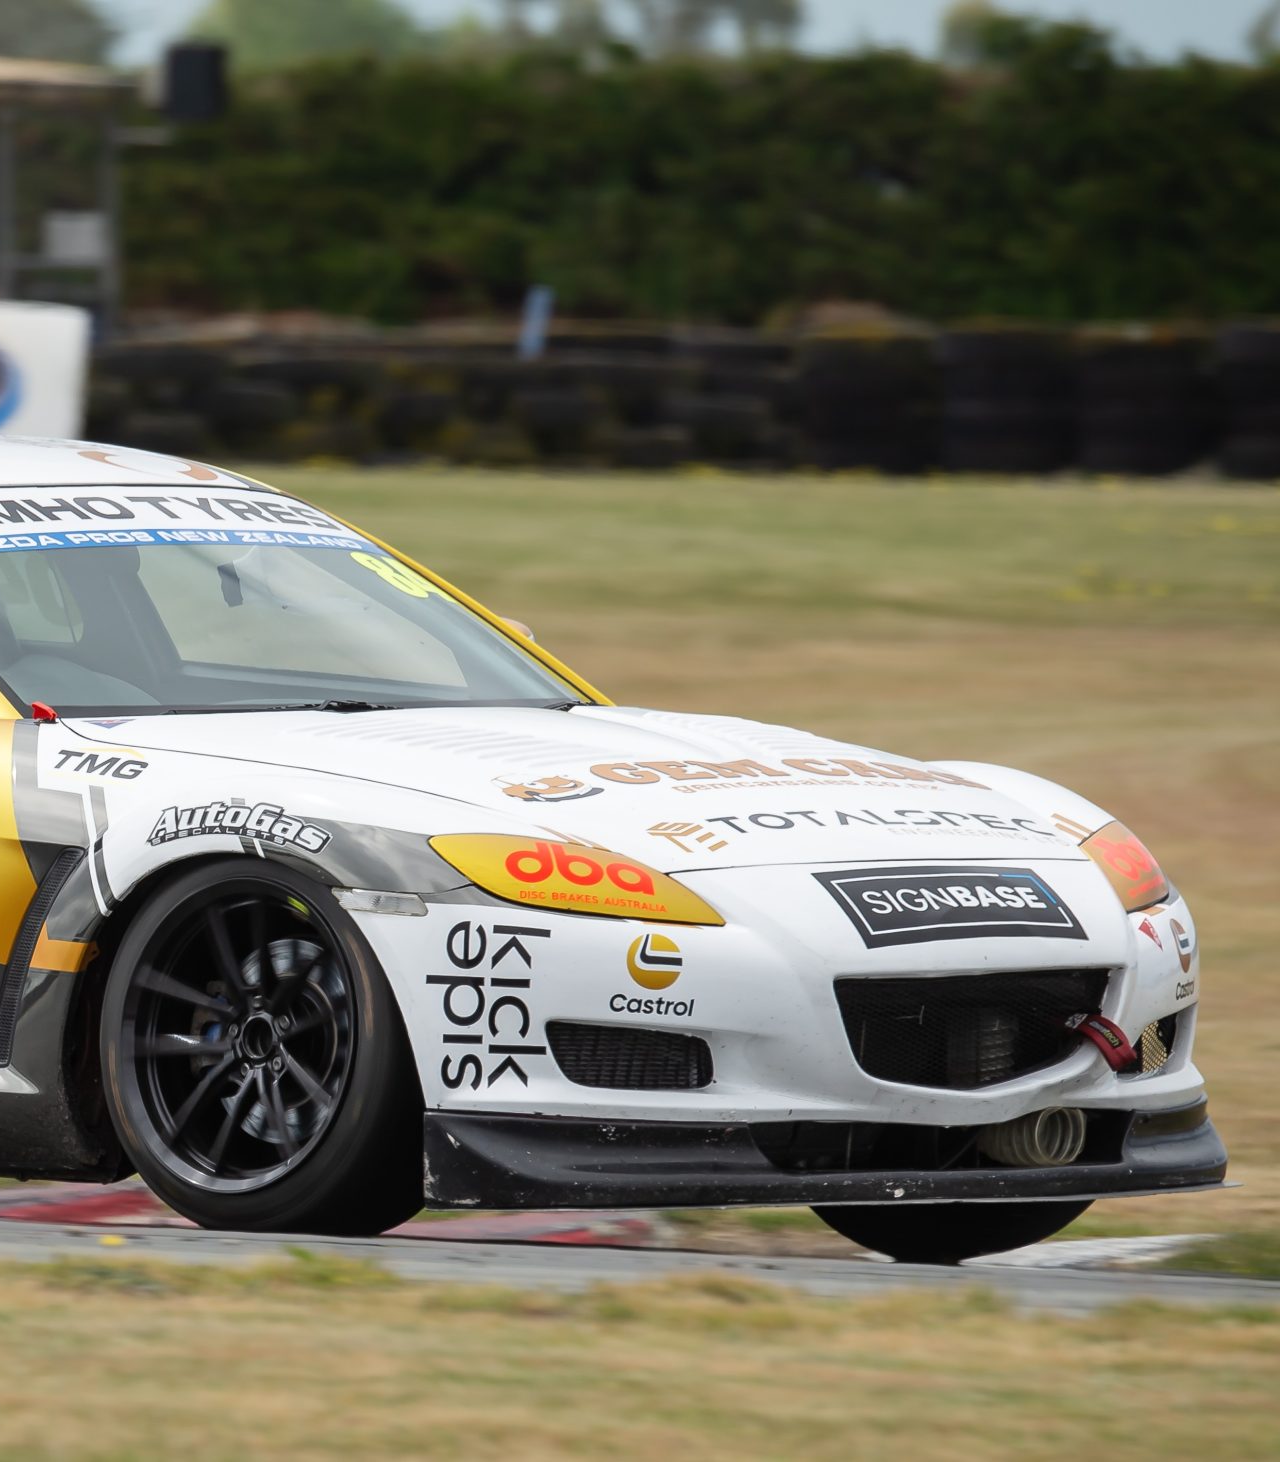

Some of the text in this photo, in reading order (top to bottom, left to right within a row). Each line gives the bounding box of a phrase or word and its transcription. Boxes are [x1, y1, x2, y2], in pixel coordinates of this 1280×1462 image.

[127, 496, 342, 530] TYRES
[162, 530, 227, 543] NEW
[234, 530, 362, 550] ZEALAND
[54, 749, 148, 779] TMG
[589, 758, 790, 784] GEM
[150, 801, 331, 853] AutoGas
[151, 826, 285, 847] SPECIALISTS
[705, 809, 1057, 837] TOTALSPEC
[505, 842, 655, 896] dba
[519, 889, 668, 913] DISC BRAKES AUSTRALIA
[861, 885, 1048, 915] SIGNBASE
[609, 993, 695, 1017] Castrol
